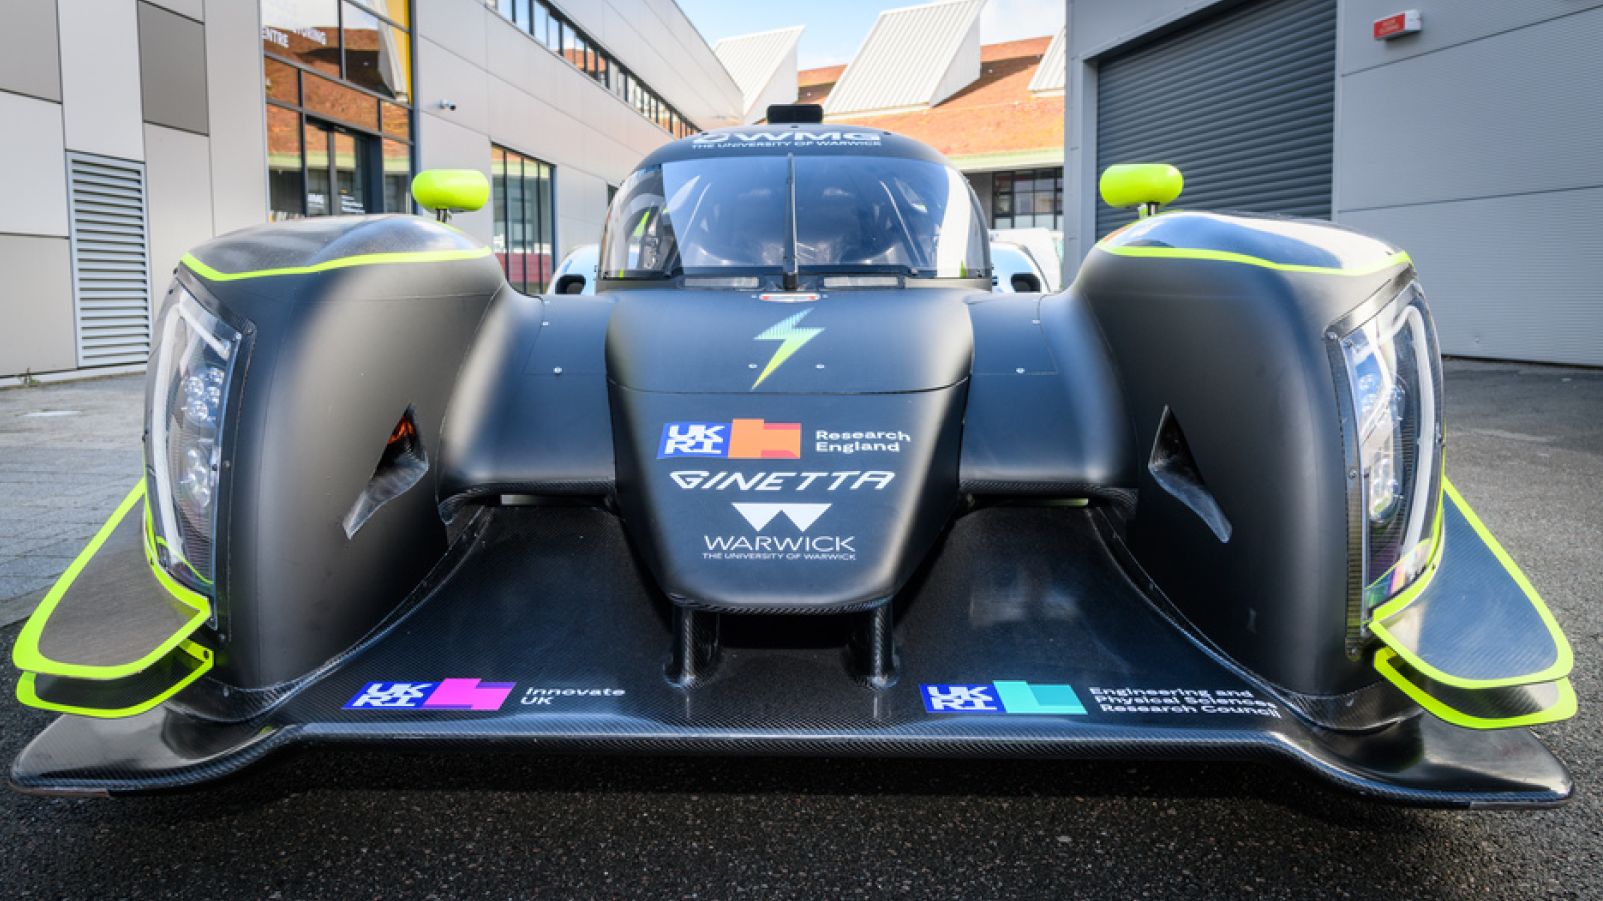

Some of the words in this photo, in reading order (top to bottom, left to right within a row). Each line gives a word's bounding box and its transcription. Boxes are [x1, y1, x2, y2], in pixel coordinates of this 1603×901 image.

[717, 141, 791, 149] UNIVERSITY
[815, 429, 912, 443] Research
[815, 441, 900, 455] England
[669, 470, 897, 491] GINETTA
[703, 534, 857, 553] WARWICK
[702, 552, 723, 560] THE
[724, 552, 785, 560] UNIVERSITY
[785, 552, 802, 560] OF
[803, 552, 857, 561] WARWICK
[525, 686, 627, 697] Innovate
[1088, 686, 1211, 698] Engineering
[1215, 689, 1254, 698] and
[520, 696, 553, 706] UK
[1094, 695, 1181, 705] Physical
[1183, 696, 1278, 709] Sciences
[1100, 703, 1199, 713] Research
[1200, 705, 1282, 719] Council
